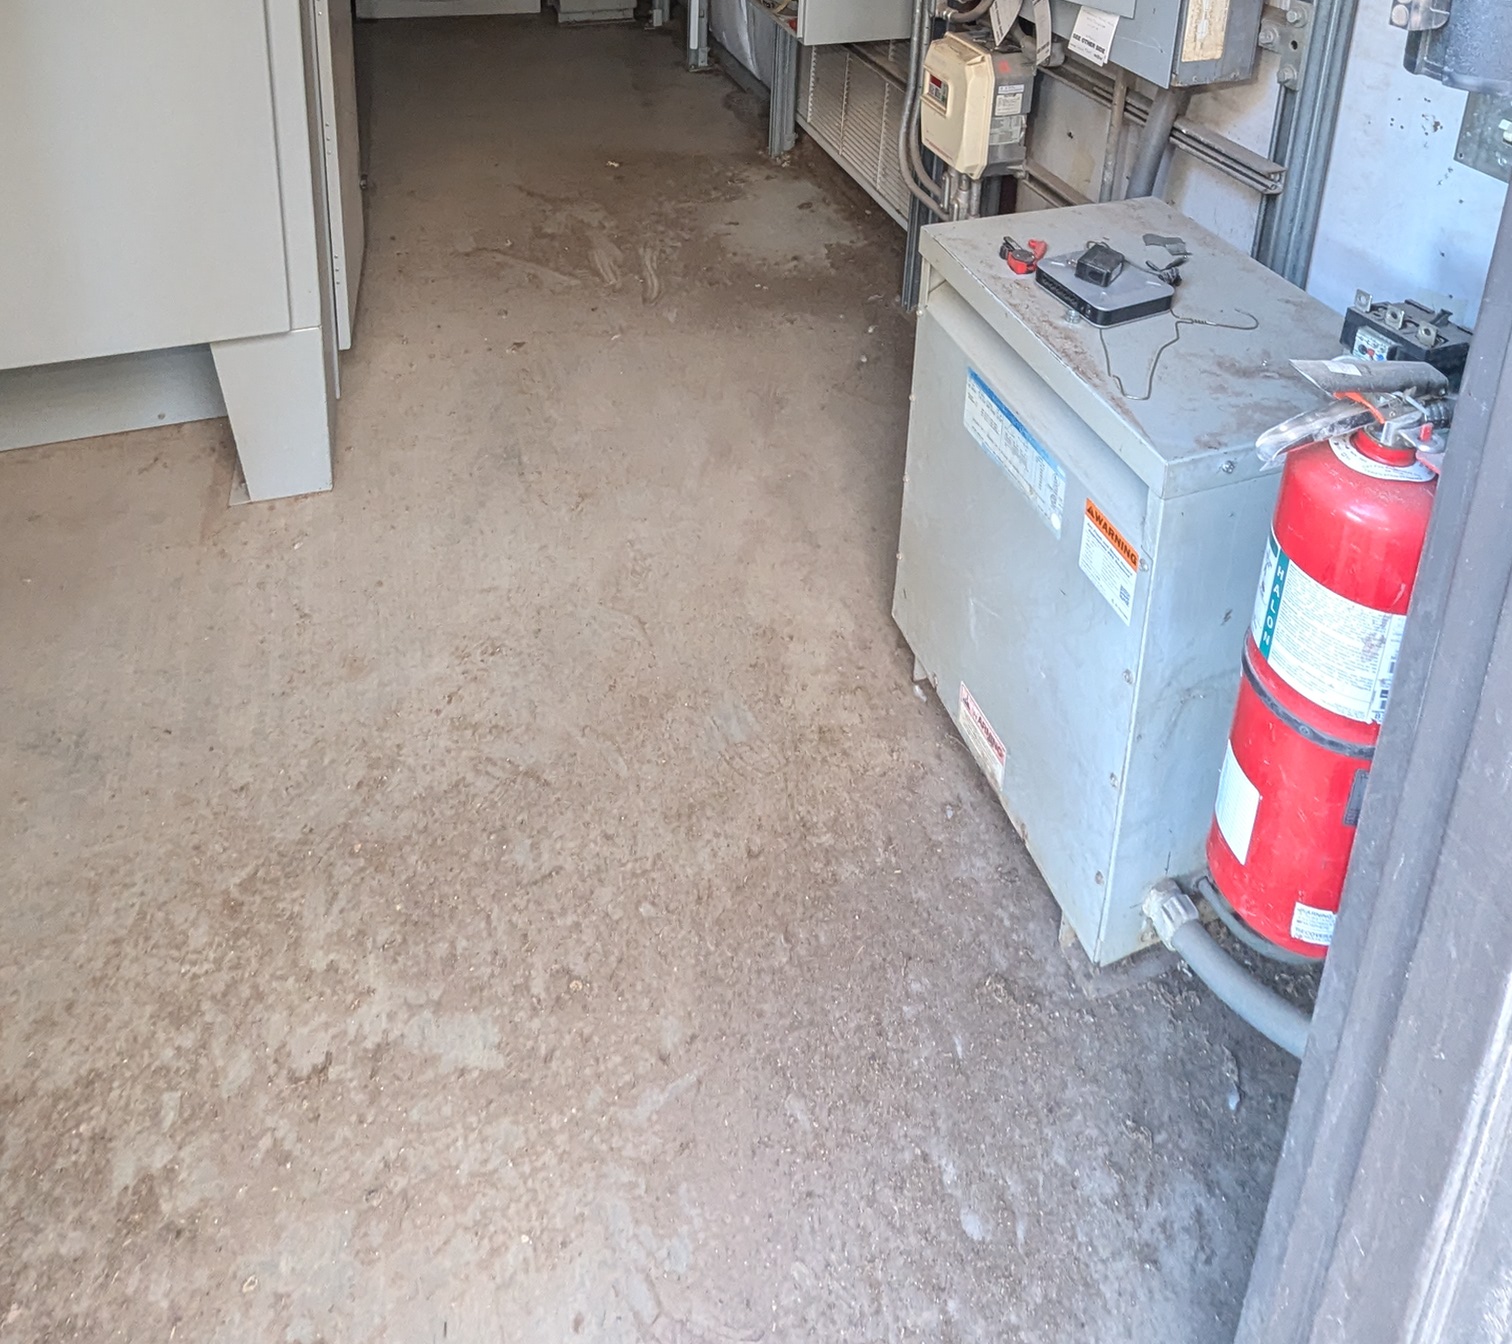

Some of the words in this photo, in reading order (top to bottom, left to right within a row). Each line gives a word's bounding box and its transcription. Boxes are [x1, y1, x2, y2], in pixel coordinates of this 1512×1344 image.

[1073, 33, 1081, 42] SEE
[1082, 37, 1095, 48] OTHER
[1096, 45, 1105, 54] SIDE
[1094, 511, 1137, 566] WARNING
[1262, 566, 1284, 646] HALON
